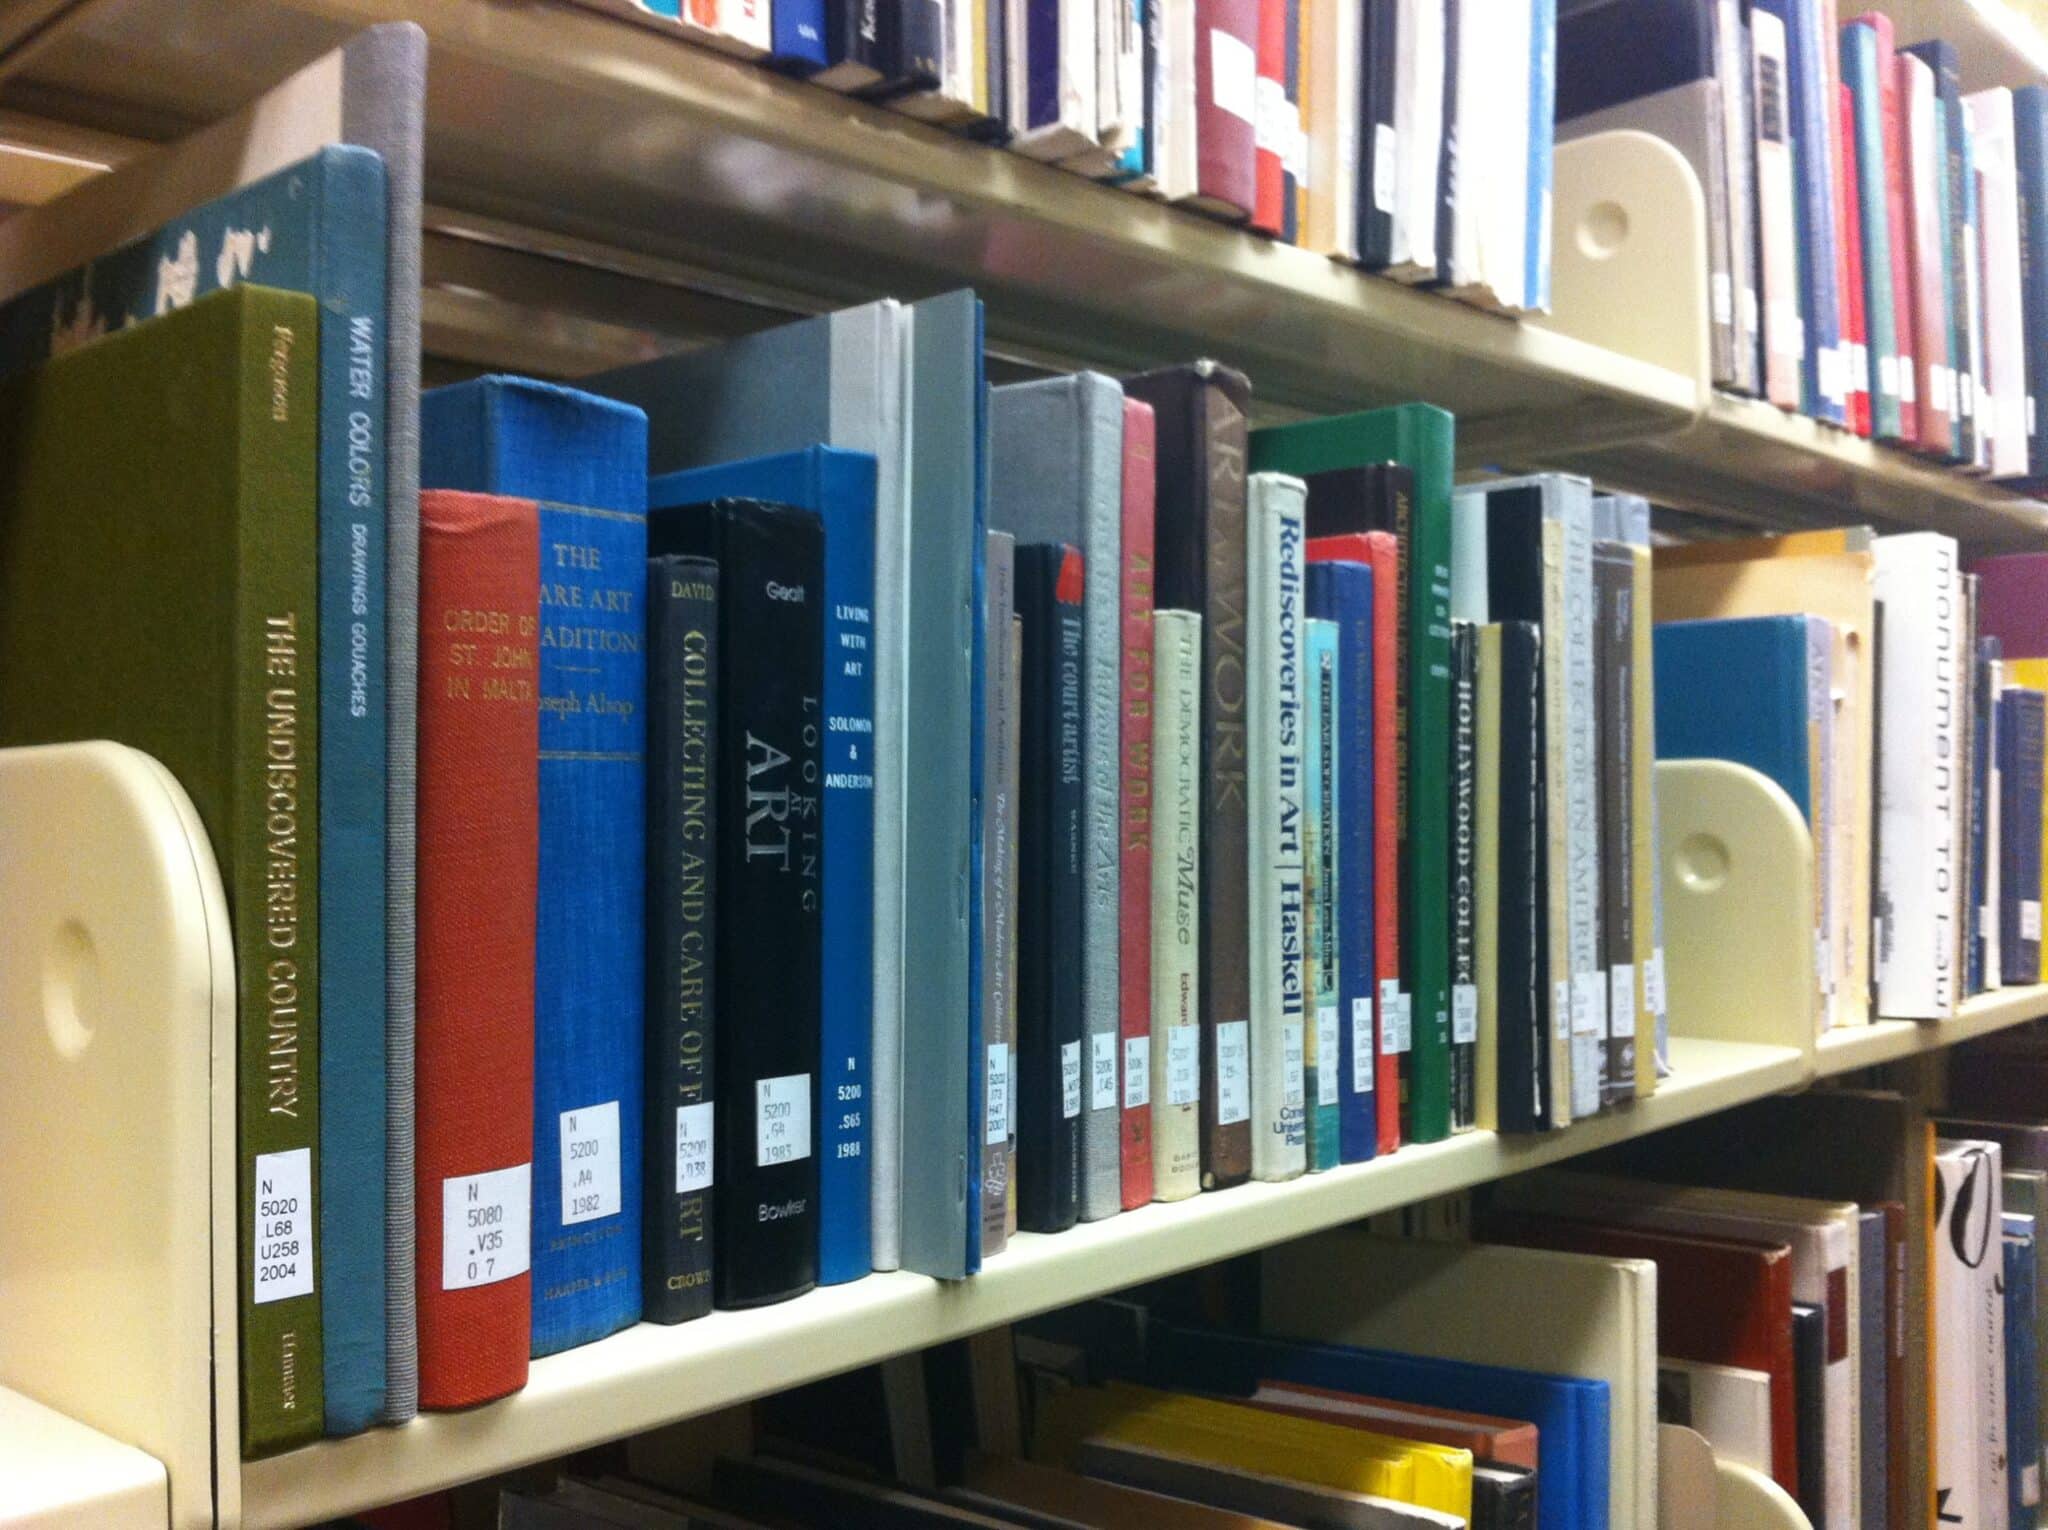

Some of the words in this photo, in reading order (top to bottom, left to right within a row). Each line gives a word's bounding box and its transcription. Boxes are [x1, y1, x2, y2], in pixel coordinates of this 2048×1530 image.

[349, 314, 374, 399] WATER
[349, 411, 373, 508] COLORS
[352, 524, 369, 616] DRAWINGS
[553, 543, 602, 571] THE
[538, 583, 584, 609] ARE
[588, 588, 634, 614] ART
[671, 580, 715, 602] DAVID
[1129, 553, 1151, 622] ART
[443, 609, 509, 634] ORDER
[836, 604, 870, 623] LIVING
[265, 612, 297, 676] THE
[541, 626, 640, 654] ADITION
[840, 632, 866, 650] WITH
[1062, 616, 1082, 656] The
[1279, 515, 1301, 746] Rediscoveries
[449, 643, 477, 665] ST
[843, 661, 863, 677] ART
[1179, 633, 1193, 680] THE
[351, 623, 367, 718] GOUACHES
[1128, 648, 1151, 718] FOR
[447, 676, 470, 700] IN
[1061, 662, 1081, 720] court
[1213, 588, 1244, 812] WORK
[538, 690, 582, 721] oseph
[682, 629, 707, 842] COLLECTING
[828, 715, 873, 734] SOLOMON
[849, 743, 858, 761] &
[1062, 723, 1082, 785] artist
[1177, 687, 1192, 842] DEMOCRATIC
[825, 773, 873, 790] ANDERSON
[1280, 755, 1301, 788] in
[1457, 679, 1472, 867] HOLLYWOOD
[745, 730, 792, 872] ART
[801, 695, 818, 913] LOOKING
[1127, 741, 1150, 853] WORK
[265, 688, 298, 948] UNDISCOVERED
[1280, 796, 1300, 854] Art
[681, 851, 705, 923] AND
[1176, 845, 1195, 946] Muse
[1573, 841, 1590, 972] AMERIC
[1456, 874, 1471, 984] COLLEC
[1281, 880, 1302, 1015] Haskell
[679, 929, 705, 1023] CARE
[993, 991, 1004, 1044] Collectio
[267, 959, 299, 1118] COUNTRY
[679, 1029, 704, 1076] OF
[846, 1057, 857, 1071] N
[763, 1083, 771, 1099] N
[837, 1084, 863, 1101] 5200
[569, 1116, 577, 1132] N
[764, 1101, 791, 1120] 5200
[838, 1115, 861, 1130] .S65
[680, 1122, 688, 1138] N
[570, 1139, 600, 1160] 5200
[679, 1139, 708, 1160] 5200
[261, 1178, 273, 1196] N
[467, 1183, 479, 1201] N
[573, 1168, 593, 1189] .A4
[260, 1197, 299, 1218] 5020
[467, 1204, 504, 1229] 5080
[571, 1193, 601, 1216] 1982
[679, 1193, 704, 1242] RT
[757, 1198, 808, 1223] Bowker
[260, 1240, 300, 1261] U258
[469, 1229, 504, 1256] .V35
[259, 1262, 297, 1283] 2004
